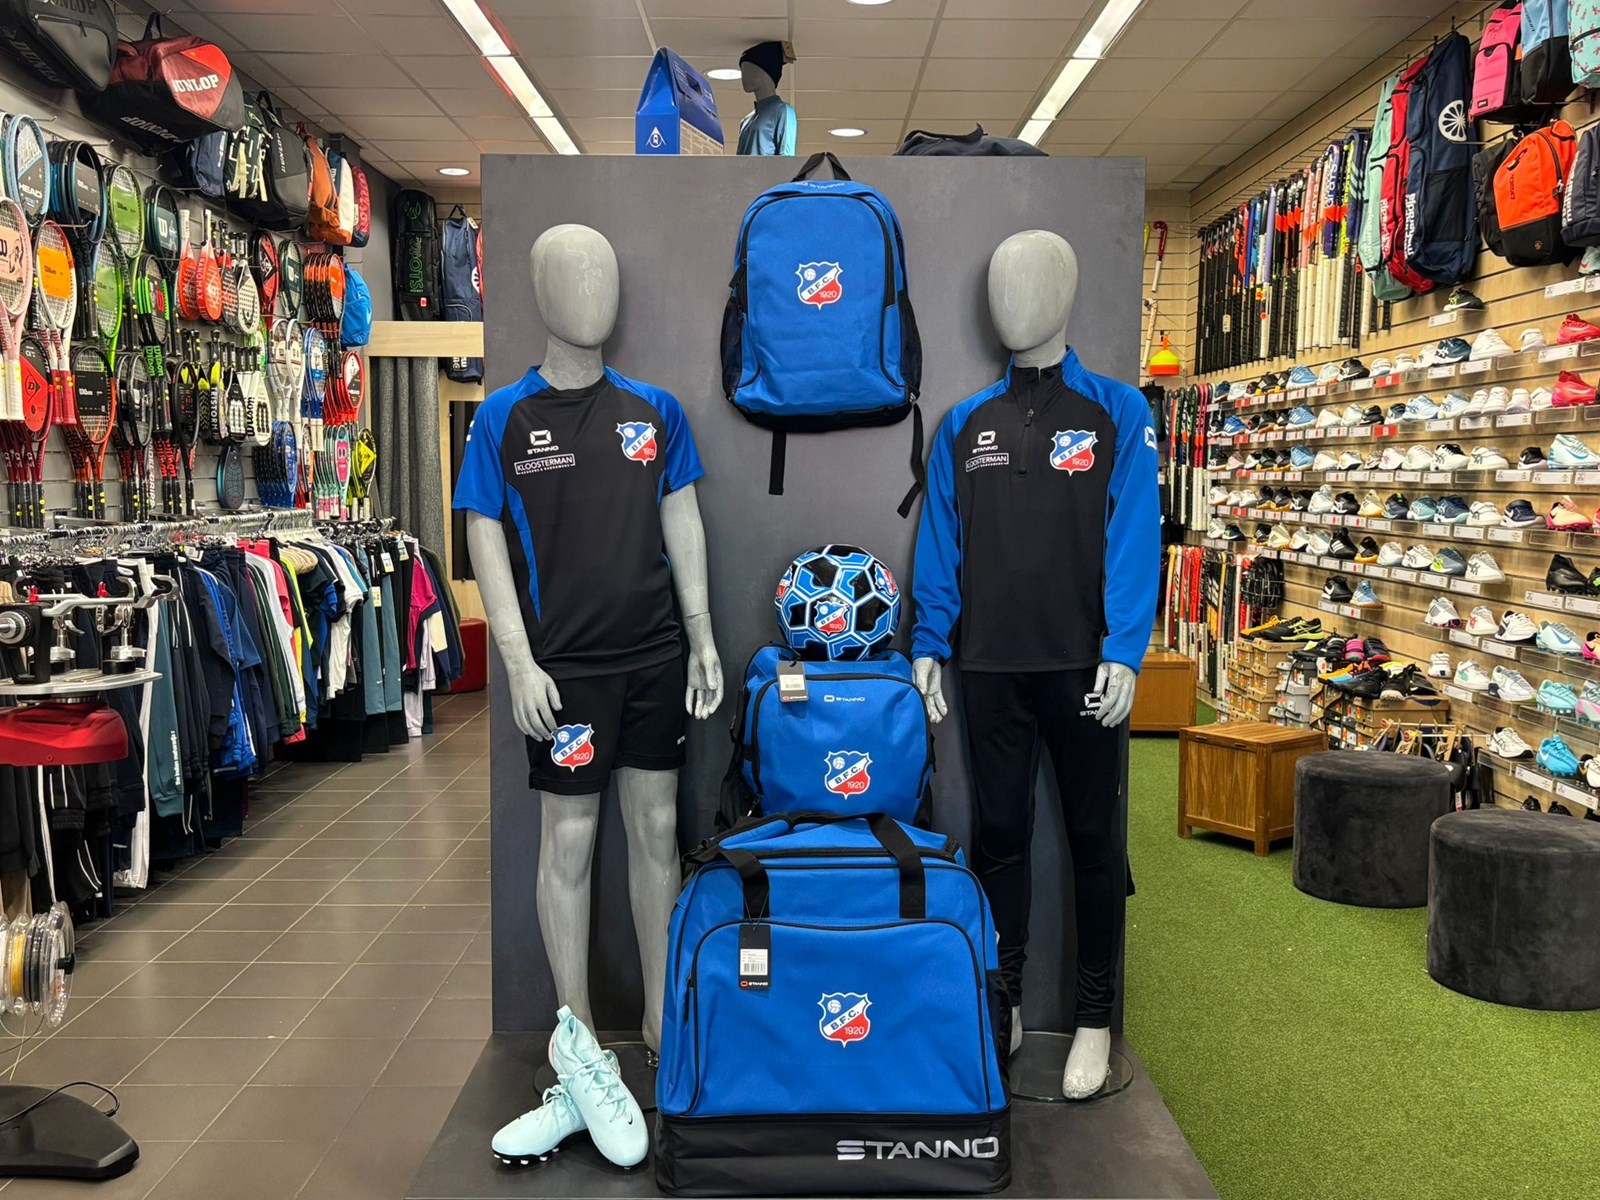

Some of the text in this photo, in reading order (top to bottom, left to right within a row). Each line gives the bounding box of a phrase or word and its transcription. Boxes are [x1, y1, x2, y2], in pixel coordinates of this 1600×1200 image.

[18, 182, 43, 199] HEAD
[195, 258, 204, 299] NANOMAX
[807, 275, 832, 296] B.F.C.
[819, 290, 837, 299] 1920
[210, 386, 218, 430] TRISTORM
[527, 445, 559, 455] STANNO
[1059, 444, 1087, 461] B.F.C.
[517, 456, 573, 472] KLOOSTERMAN
[1072, 457, 1089, 467] 1920
[1079, 709, 1099, 717] STAN
[560, 738, 586, 757] B.F.C.
[572, 752, 590, 761] 1920
[834, 766, 861, 785] B.F.C.
[847, 781, 865, 789] 1920
[830, 1008, 860, 1031] B.F.C.
[844, 1026, 865, 1035] 1920
[836, 1136, 999, 1161] STANNO
